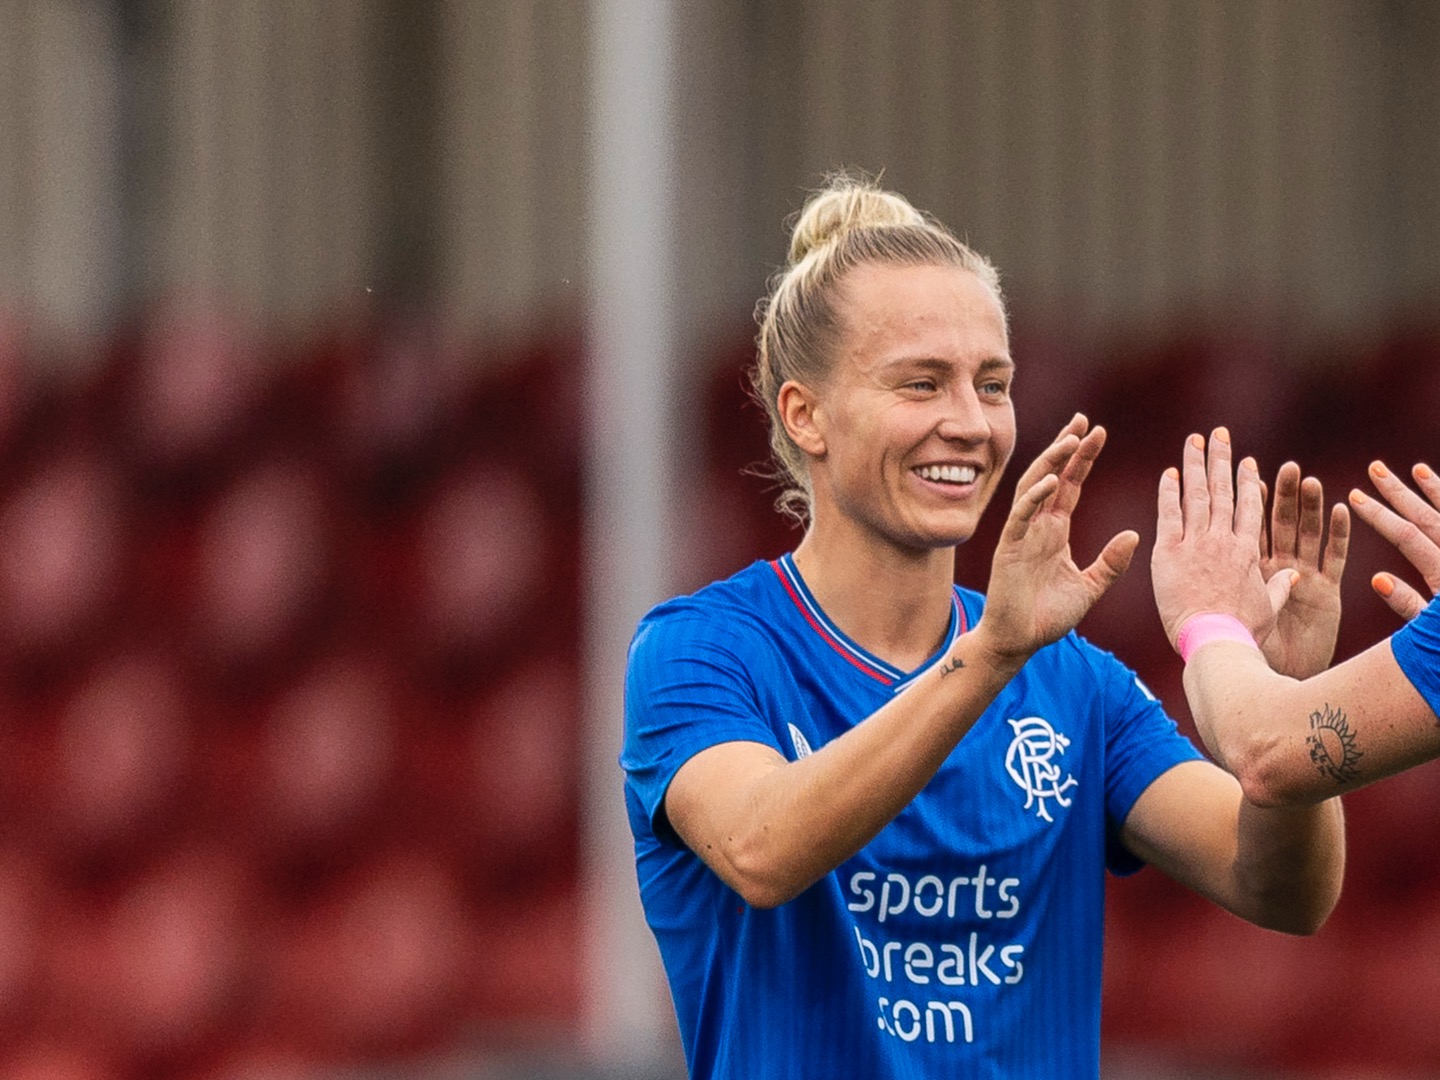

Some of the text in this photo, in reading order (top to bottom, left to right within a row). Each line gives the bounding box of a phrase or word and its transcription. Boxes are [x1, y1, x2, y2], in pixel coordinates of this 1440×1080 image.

[848, 865, 1020, 922] sports
[854, 926, 1024, 986] breaks
[878, 997, 973, 1043] .com
